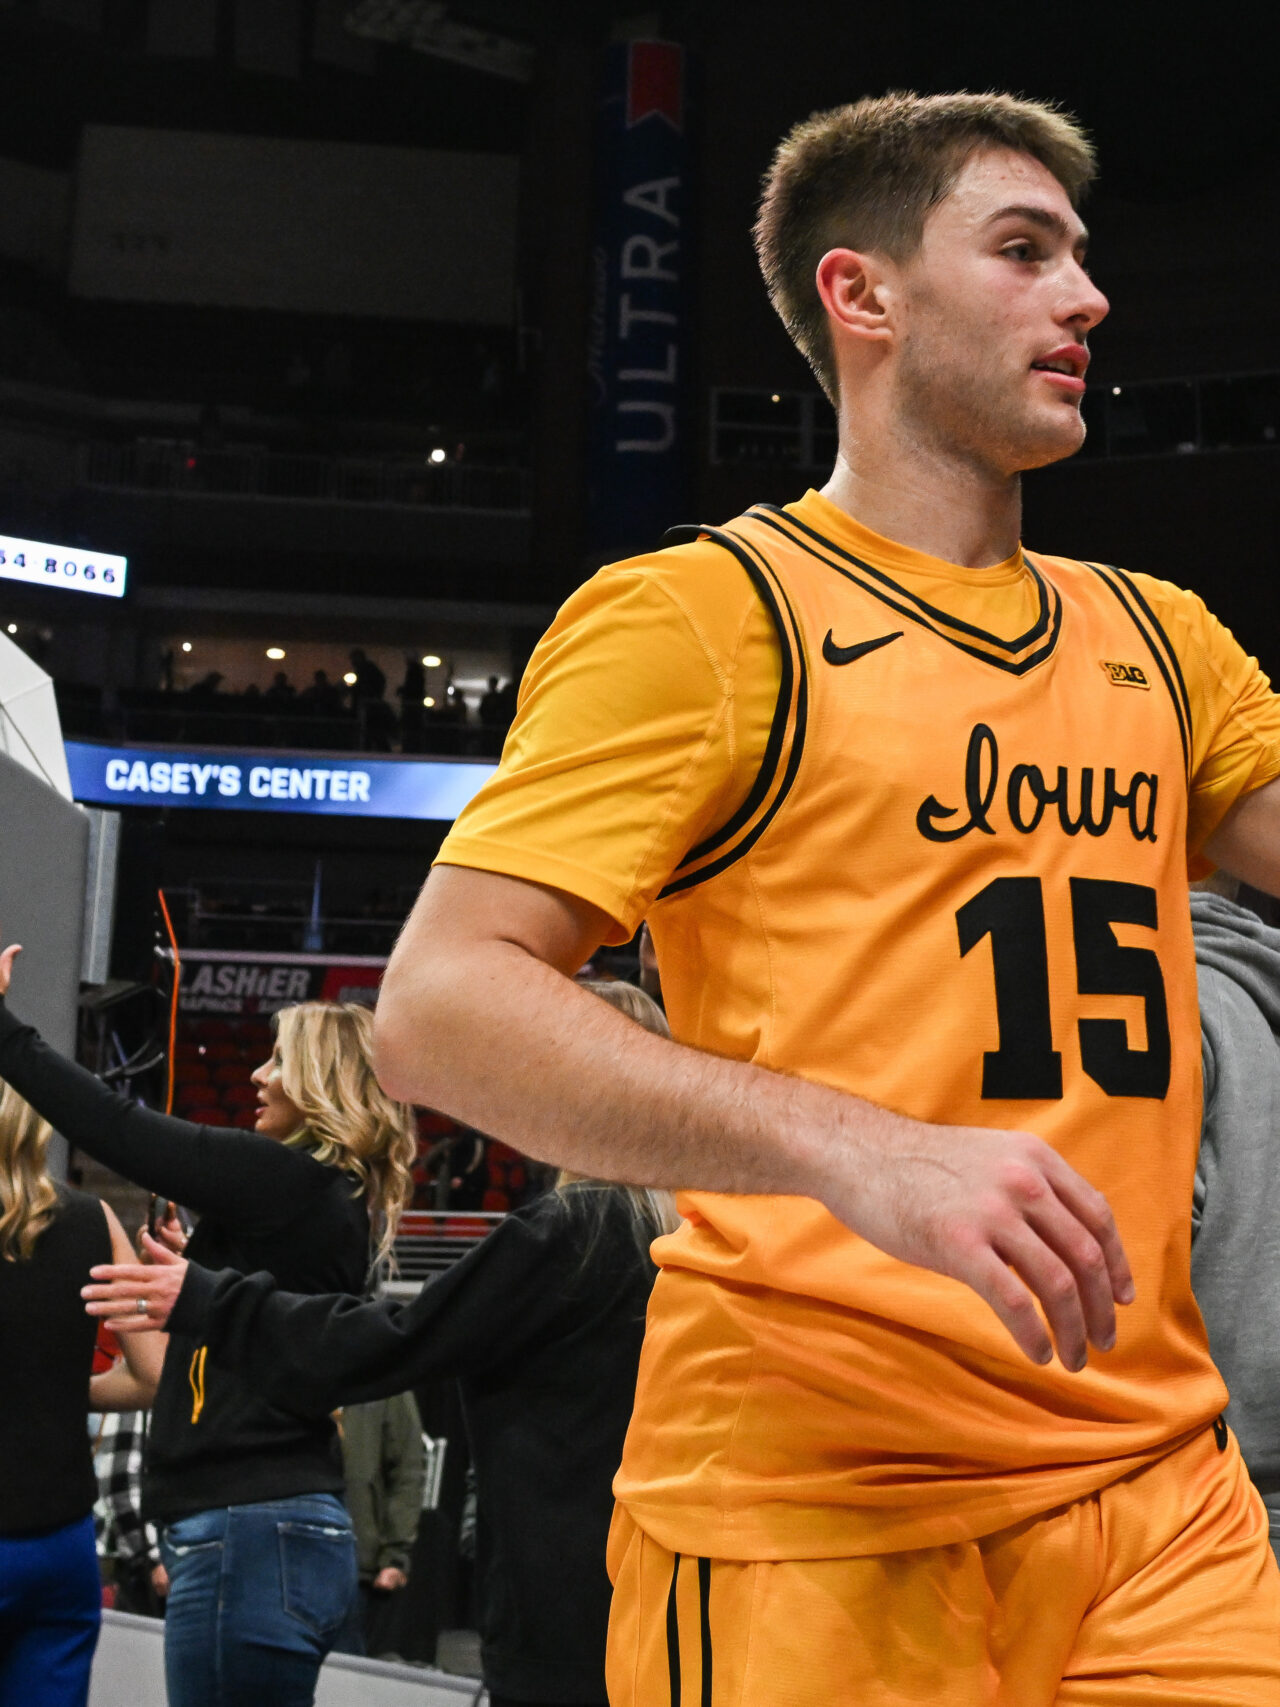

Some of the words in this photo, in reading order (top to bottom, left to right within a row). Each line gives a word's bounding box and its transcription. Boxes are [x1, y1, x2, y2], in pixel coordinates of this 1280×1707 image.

[616, 176, 681, 454] ULTRA
[45, 557, 115, 583] 8066
[105, 759, 241, 796] CASEY'S
[249, 766, 371, 802] CENTER
[916, 723, 1157, 843] Iowa
[955, 877, 1171, 1100] 15
